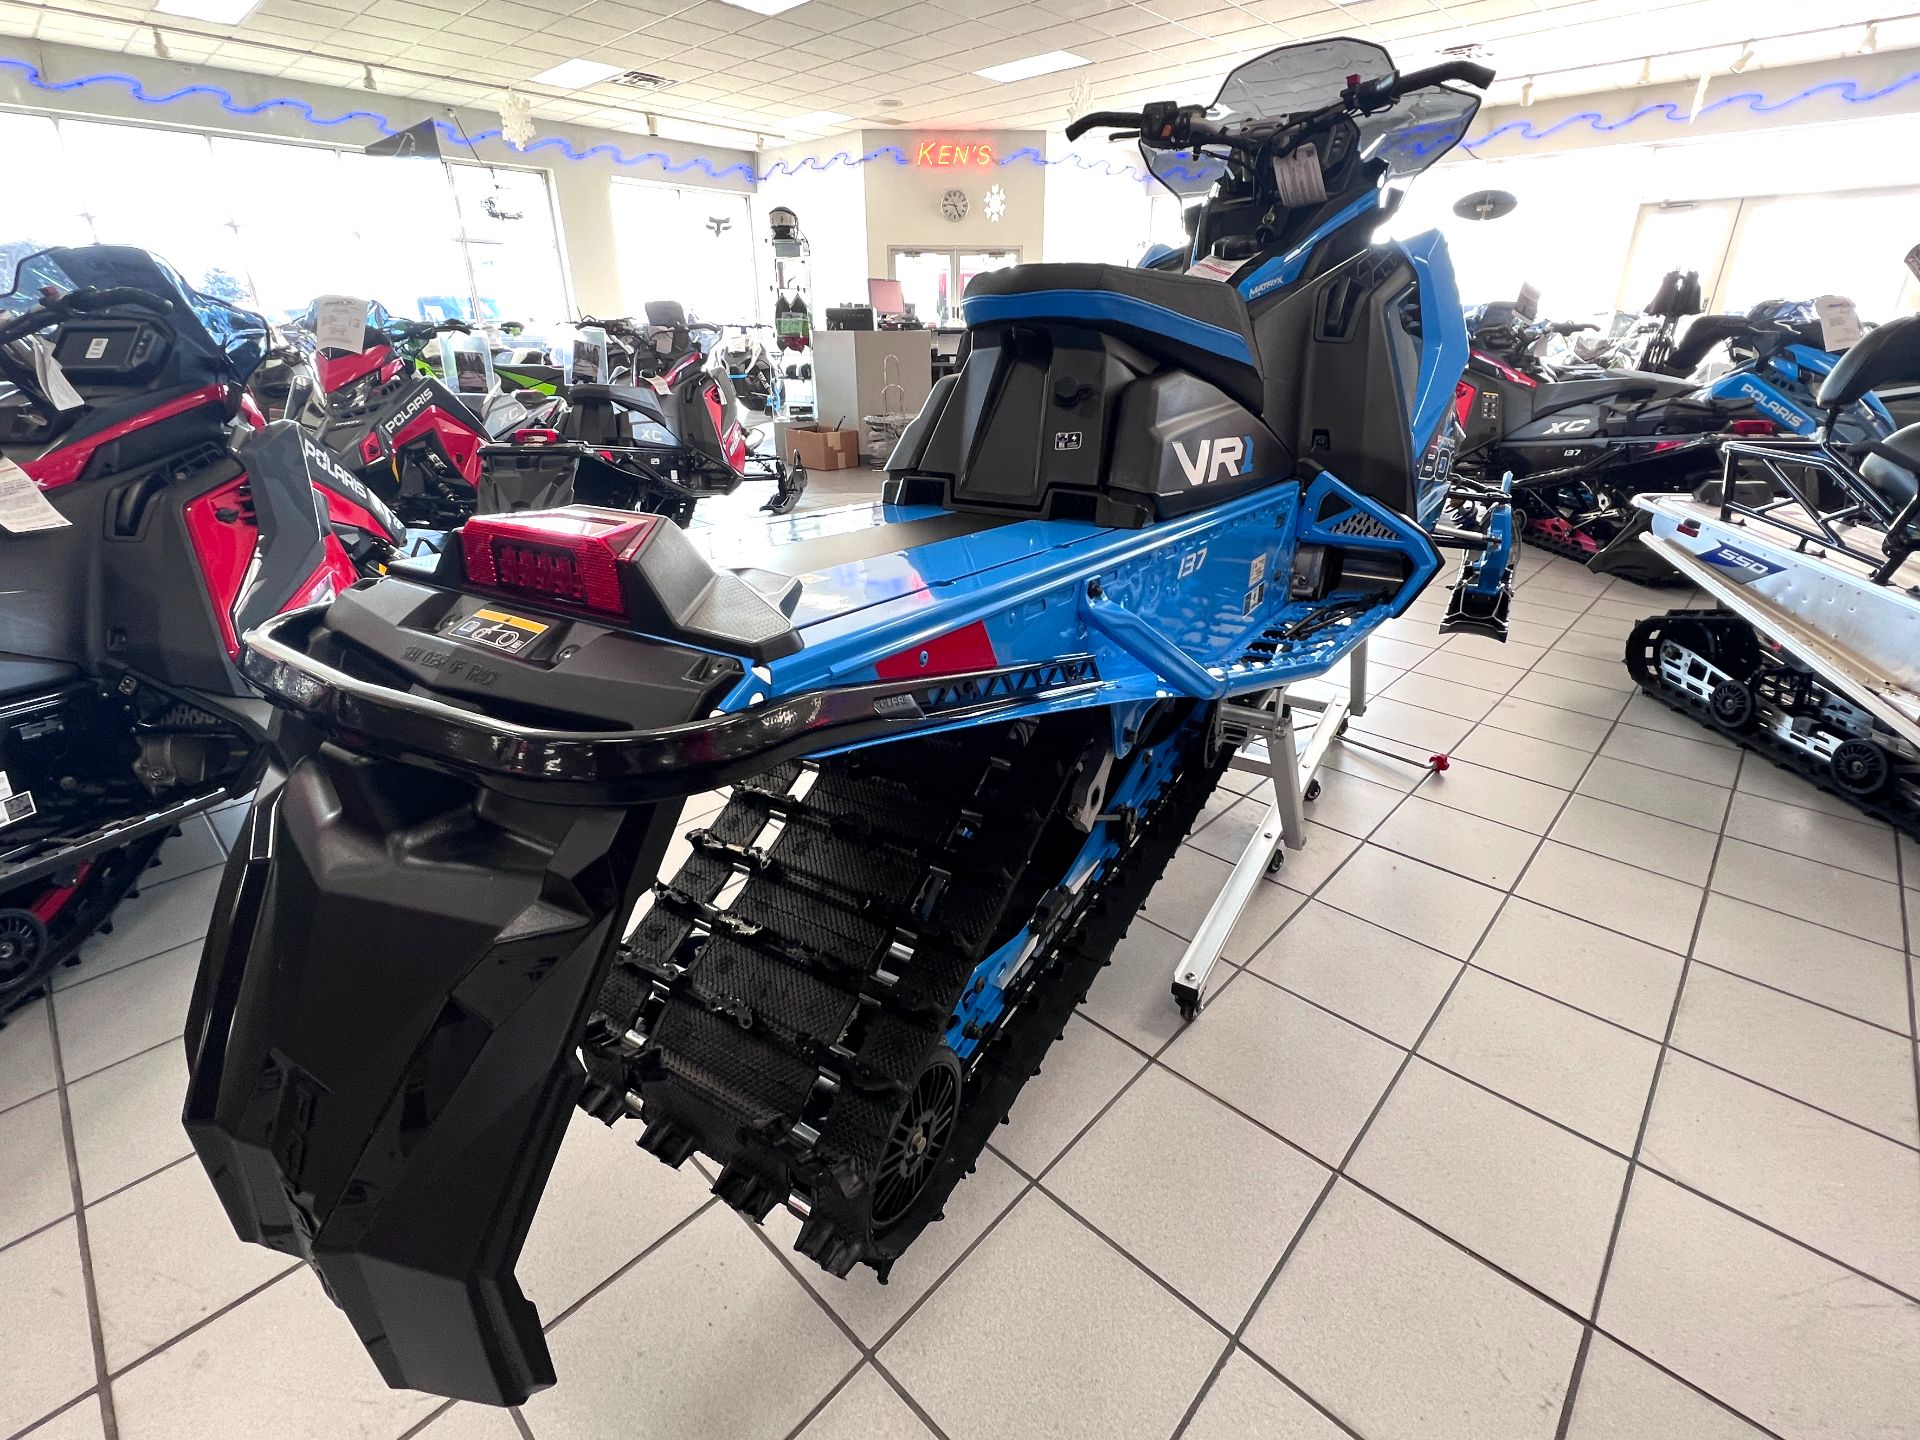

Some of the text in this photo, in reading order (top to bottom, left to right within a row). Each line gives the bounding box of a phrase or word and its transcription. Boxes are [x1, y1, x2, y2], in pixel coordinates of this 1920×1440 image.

[917, 142, 992, 165] KEN'S
[385, 387, 434, 433] POLARIS
[1541, 419, 1591, 435] XC
[1741, 383, 1803, 428] POLARIS
[641, 428, 663, 441] XC
[304, 438, 367, 499] POLARIS
[1171, 435, 1254, 486] VR1
